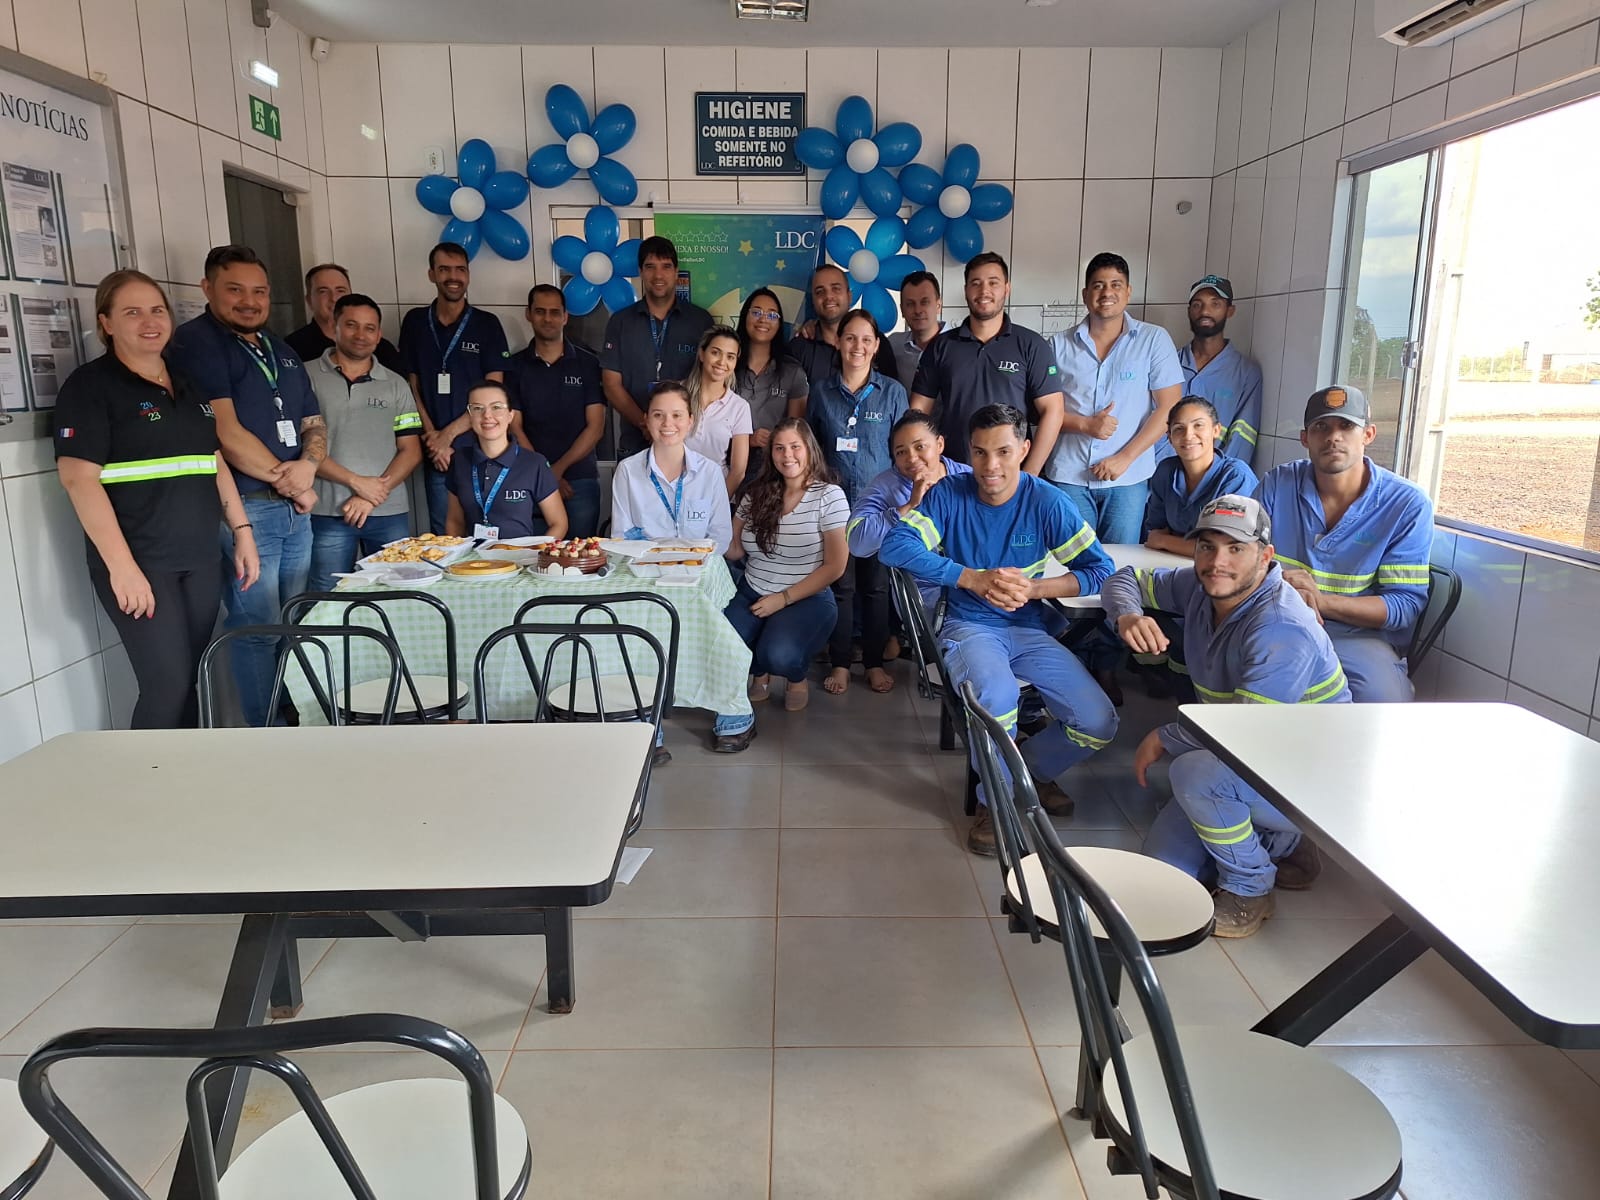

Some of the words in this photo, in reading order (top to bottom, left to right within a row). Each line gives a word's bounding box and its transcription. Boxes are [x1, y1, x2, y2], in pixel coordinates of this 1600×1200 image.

[709, 101, 791, 119] HIGIENE
[0, 91, 88, 141] NOTÍCIAS
[702, 126, 745, 138] COMIDA
[748, 126, 756, 138] E
[758, 126, 798, 138] BEBIDA
[715, 140, 767, 153] SOMENTE
[770, 141, 786, 153] NO
[718, 153, 783, 167] REFEITÓRIO
[775, 231, 815, 249] LDC
[700, 245, 729, 254] NOSSO!
[461, 341, 480, 351] LDC
[999, 360, 1020, 371] LDC
[564, 376, 583, 385] LDC
[367, 397, 388, 408] LDC
[148, 411, 161, 421] 23
[865, 411, 883, 421] LDC
[505, 490, 527, 500] LDC
[687, 510, 706, 520] LDC
[1012, 533, 1037, 545] LDC
